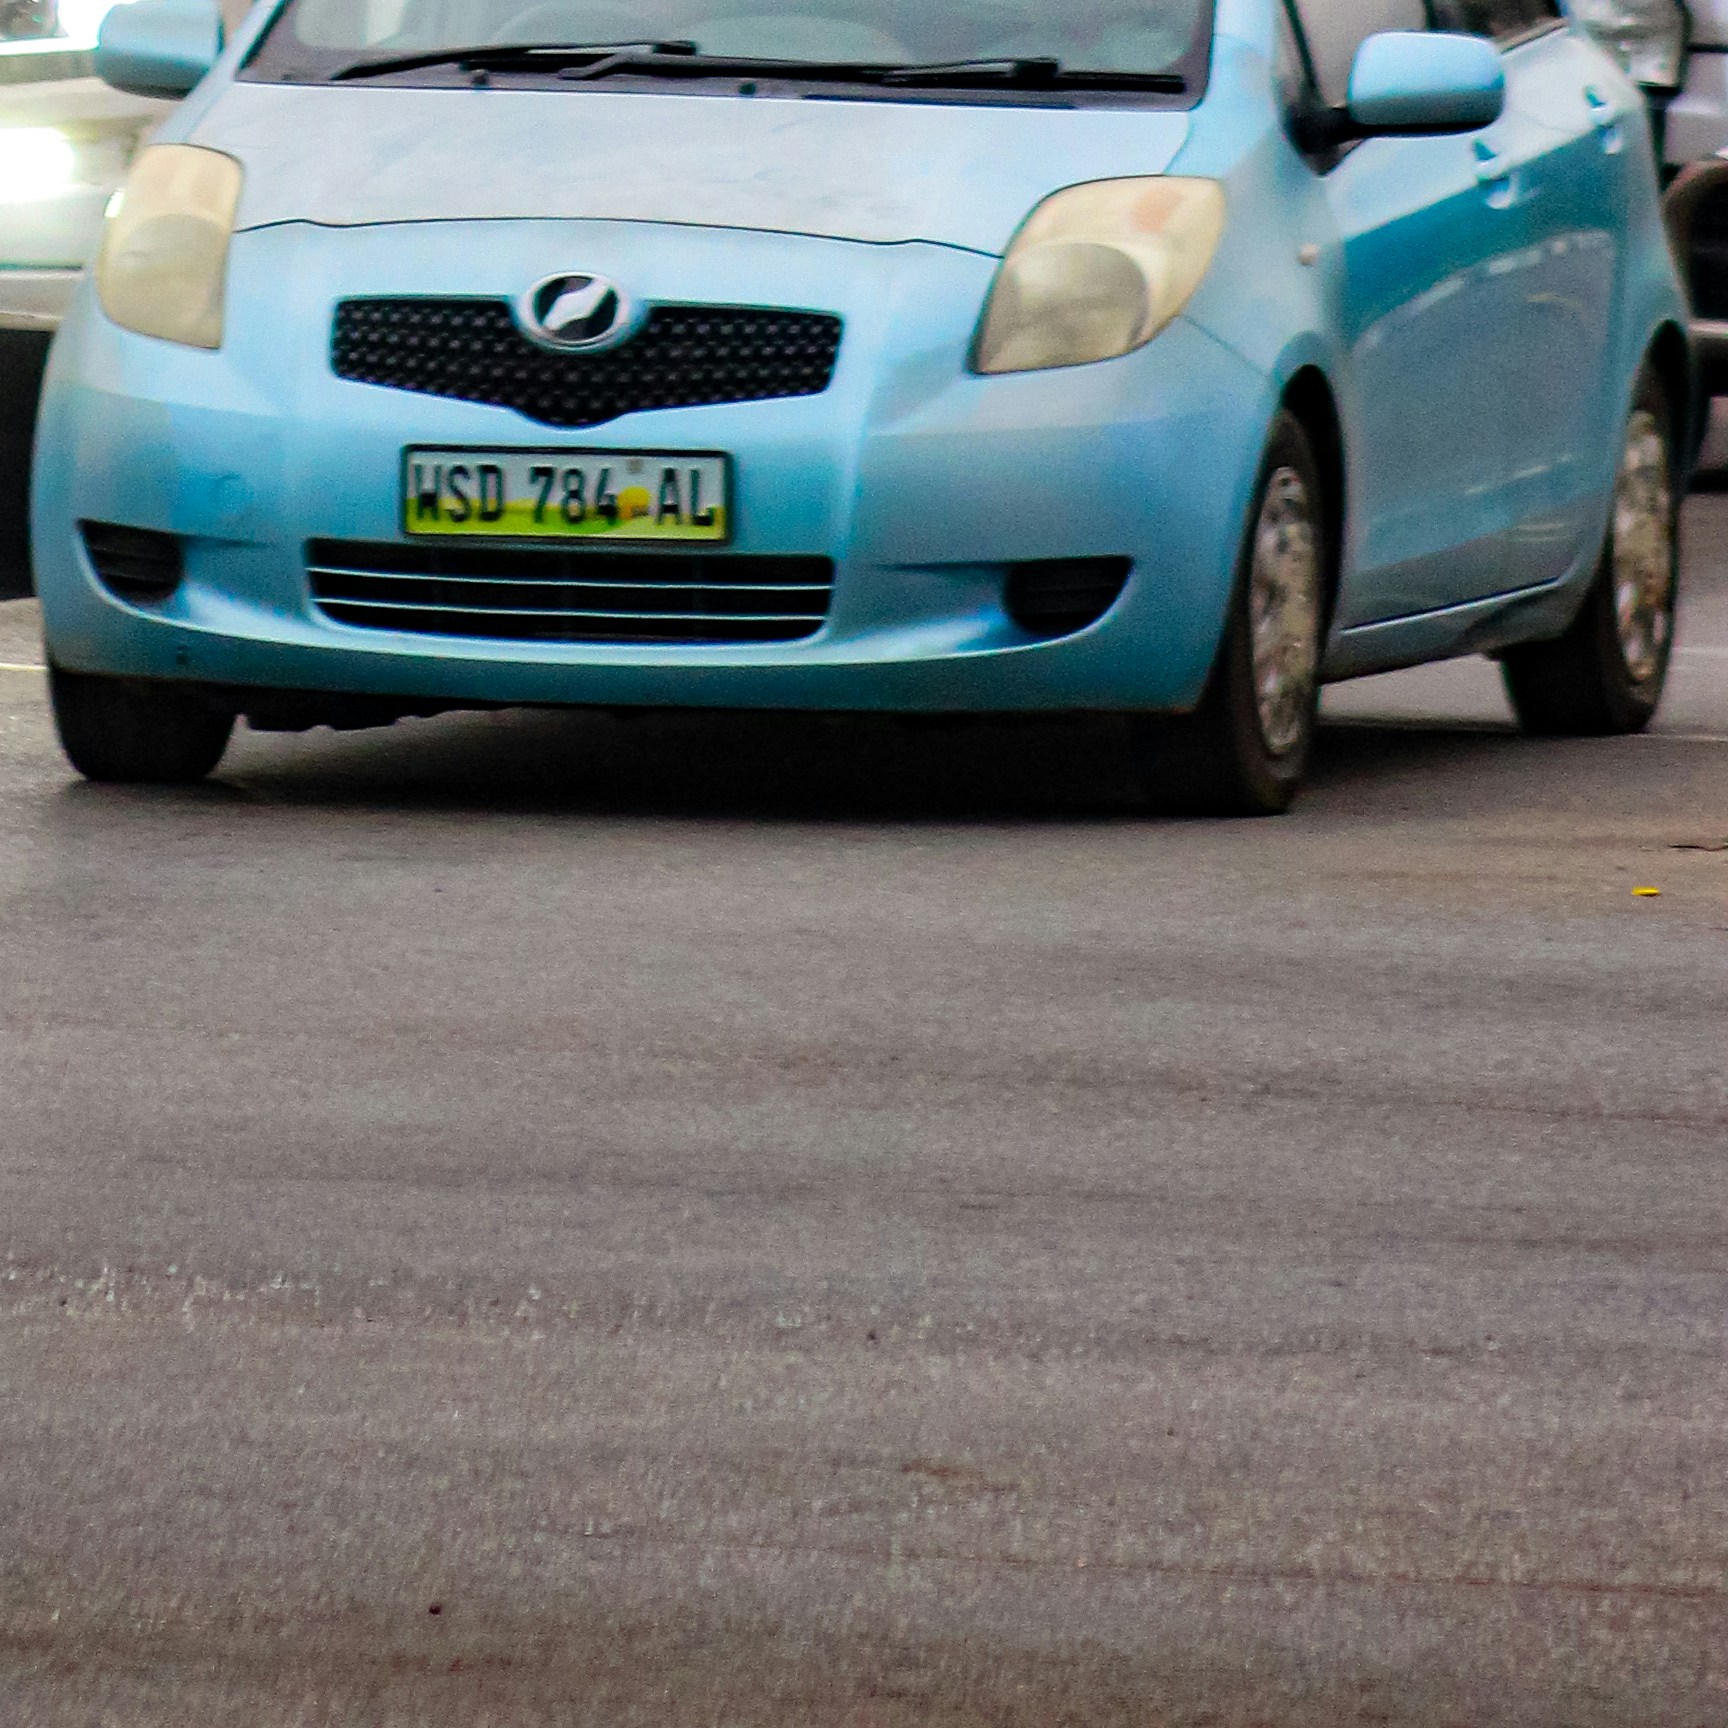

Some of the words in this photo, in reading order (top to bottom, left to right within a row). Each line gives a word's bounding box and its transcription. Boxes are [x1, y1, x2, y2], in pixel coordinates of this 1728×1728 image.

[415, 463, 504, 523] WSD
[528, 465, 619, 525] 784
[655, 466, 716, 526] AL
